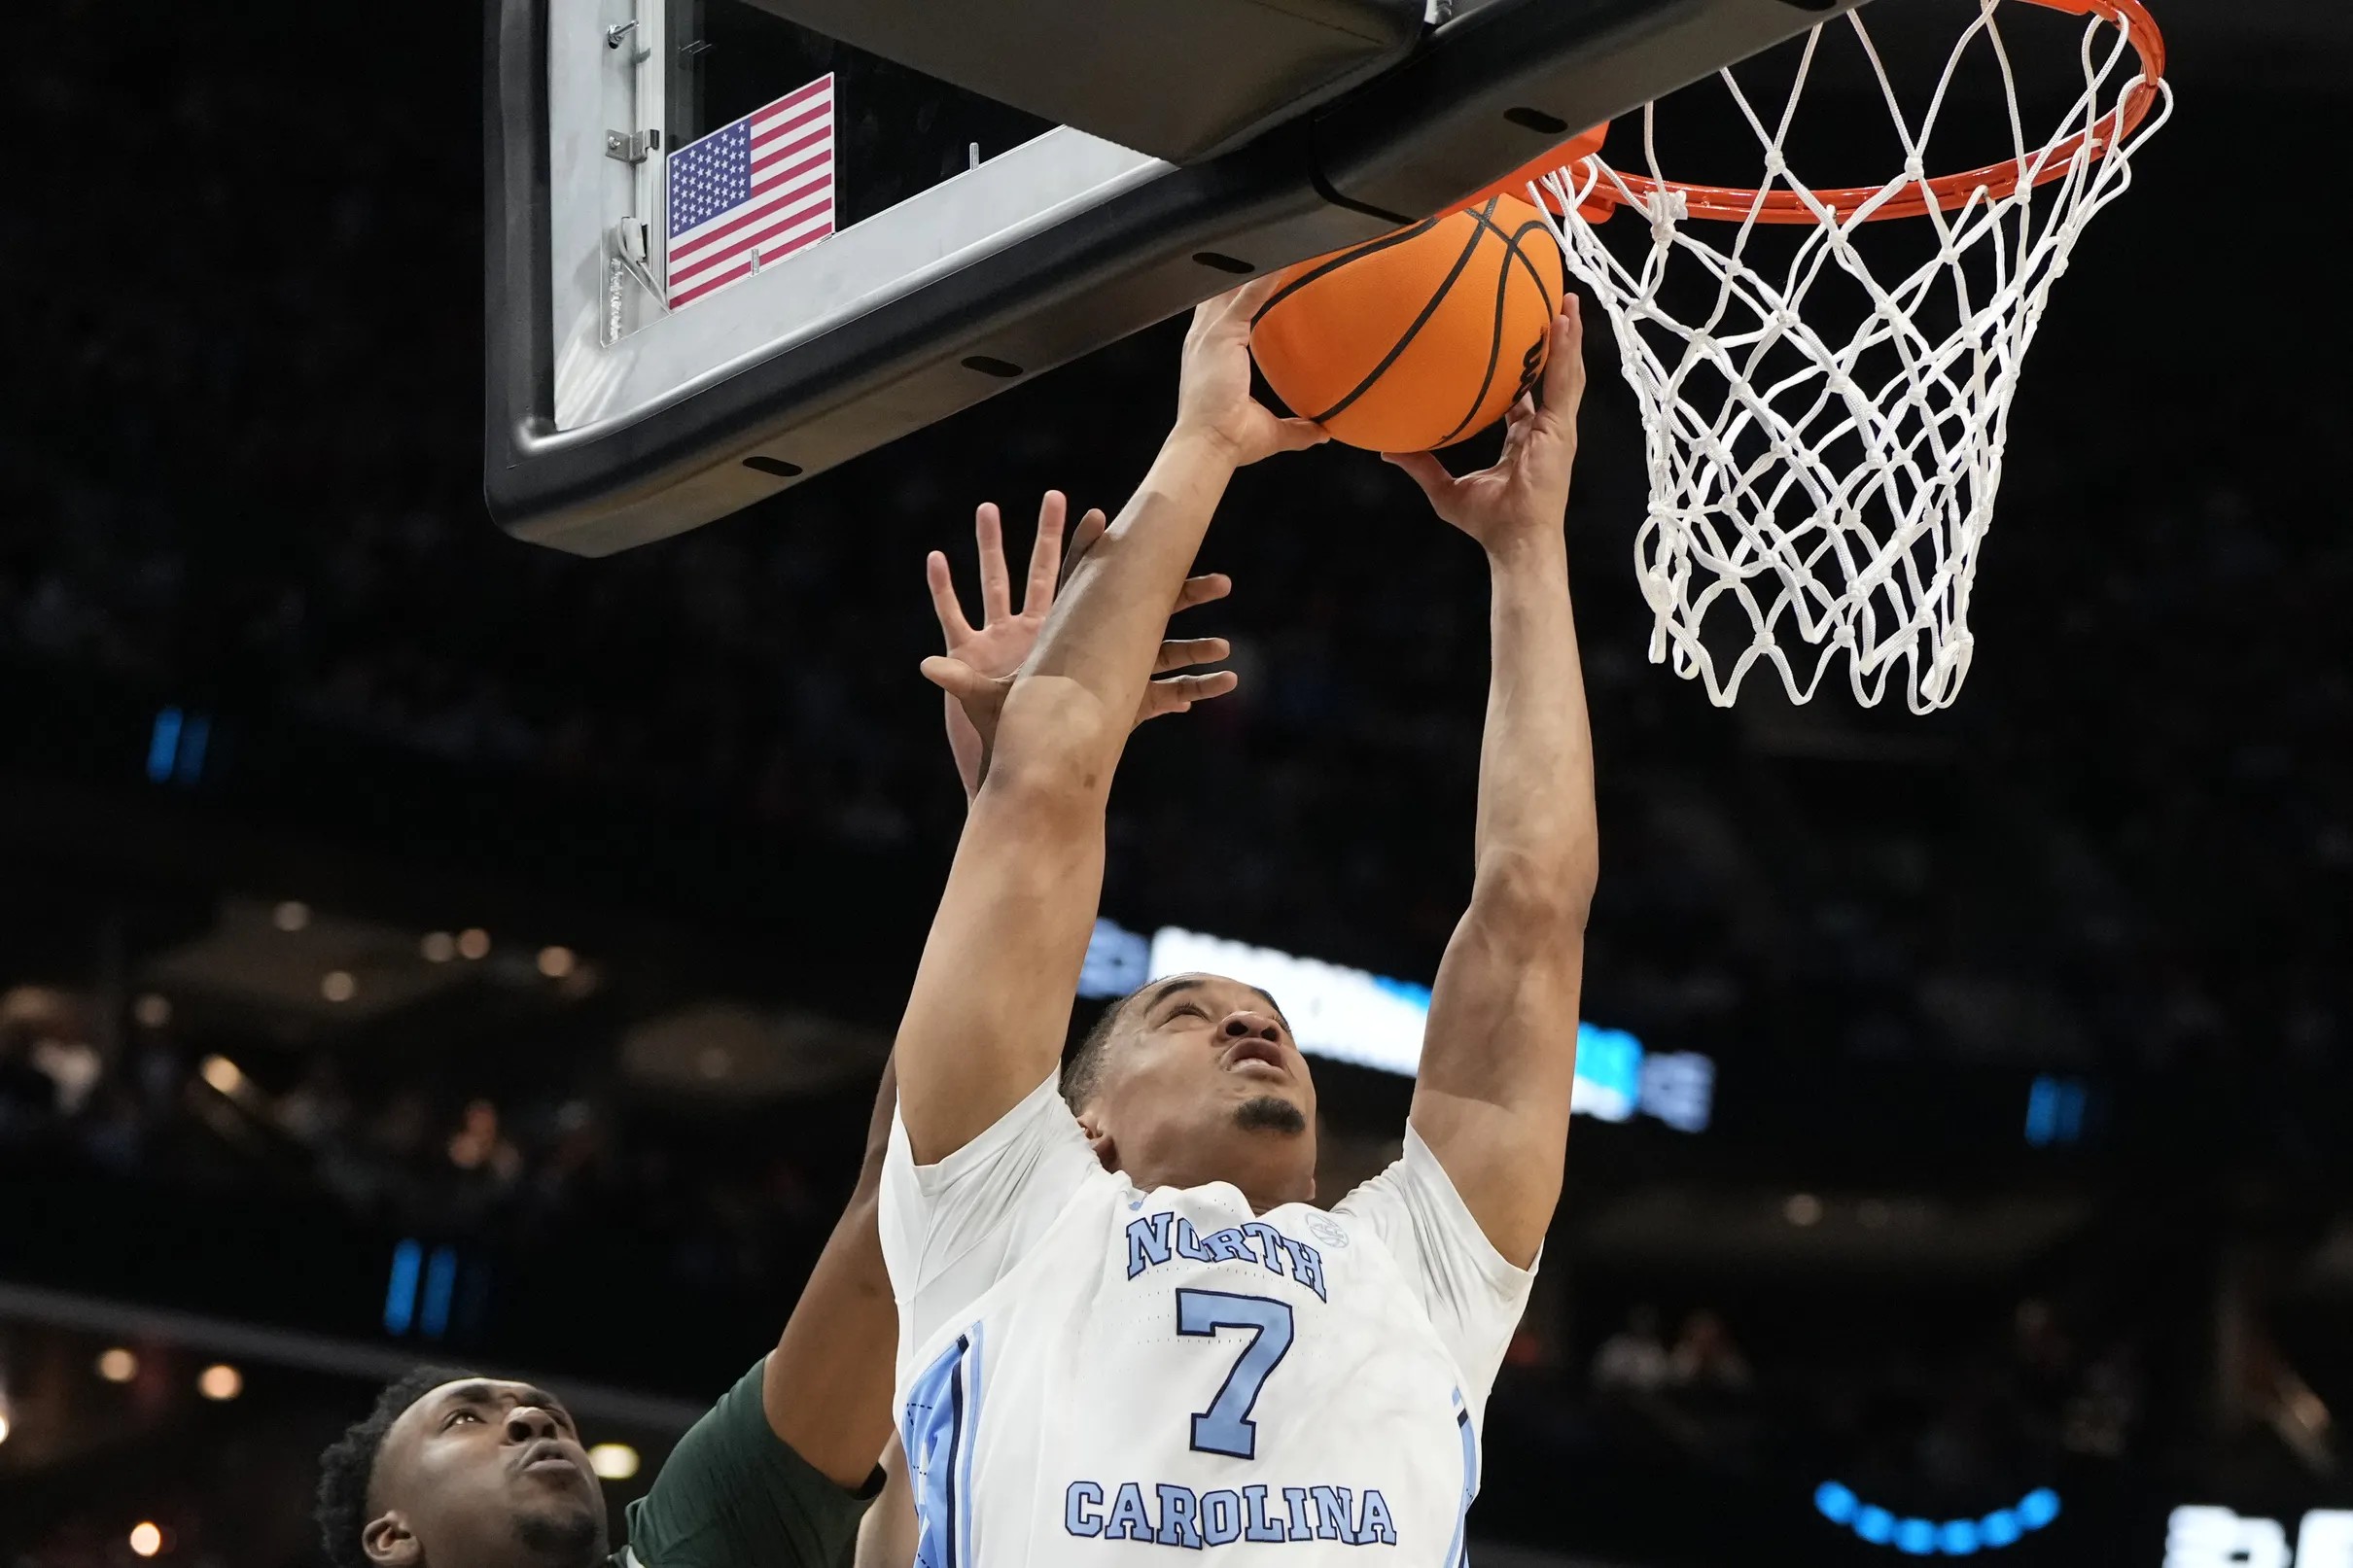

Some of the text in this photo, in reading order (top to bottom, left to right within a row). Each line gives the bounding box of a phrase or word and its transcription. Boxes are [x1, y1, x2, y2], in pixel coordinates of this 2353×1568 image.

[1126, 1211, 1326, 1304] NORTH
[1176, 1287, 1294, 1460] 7
[1065, 1481, 1396, 1550] CAROLINA
